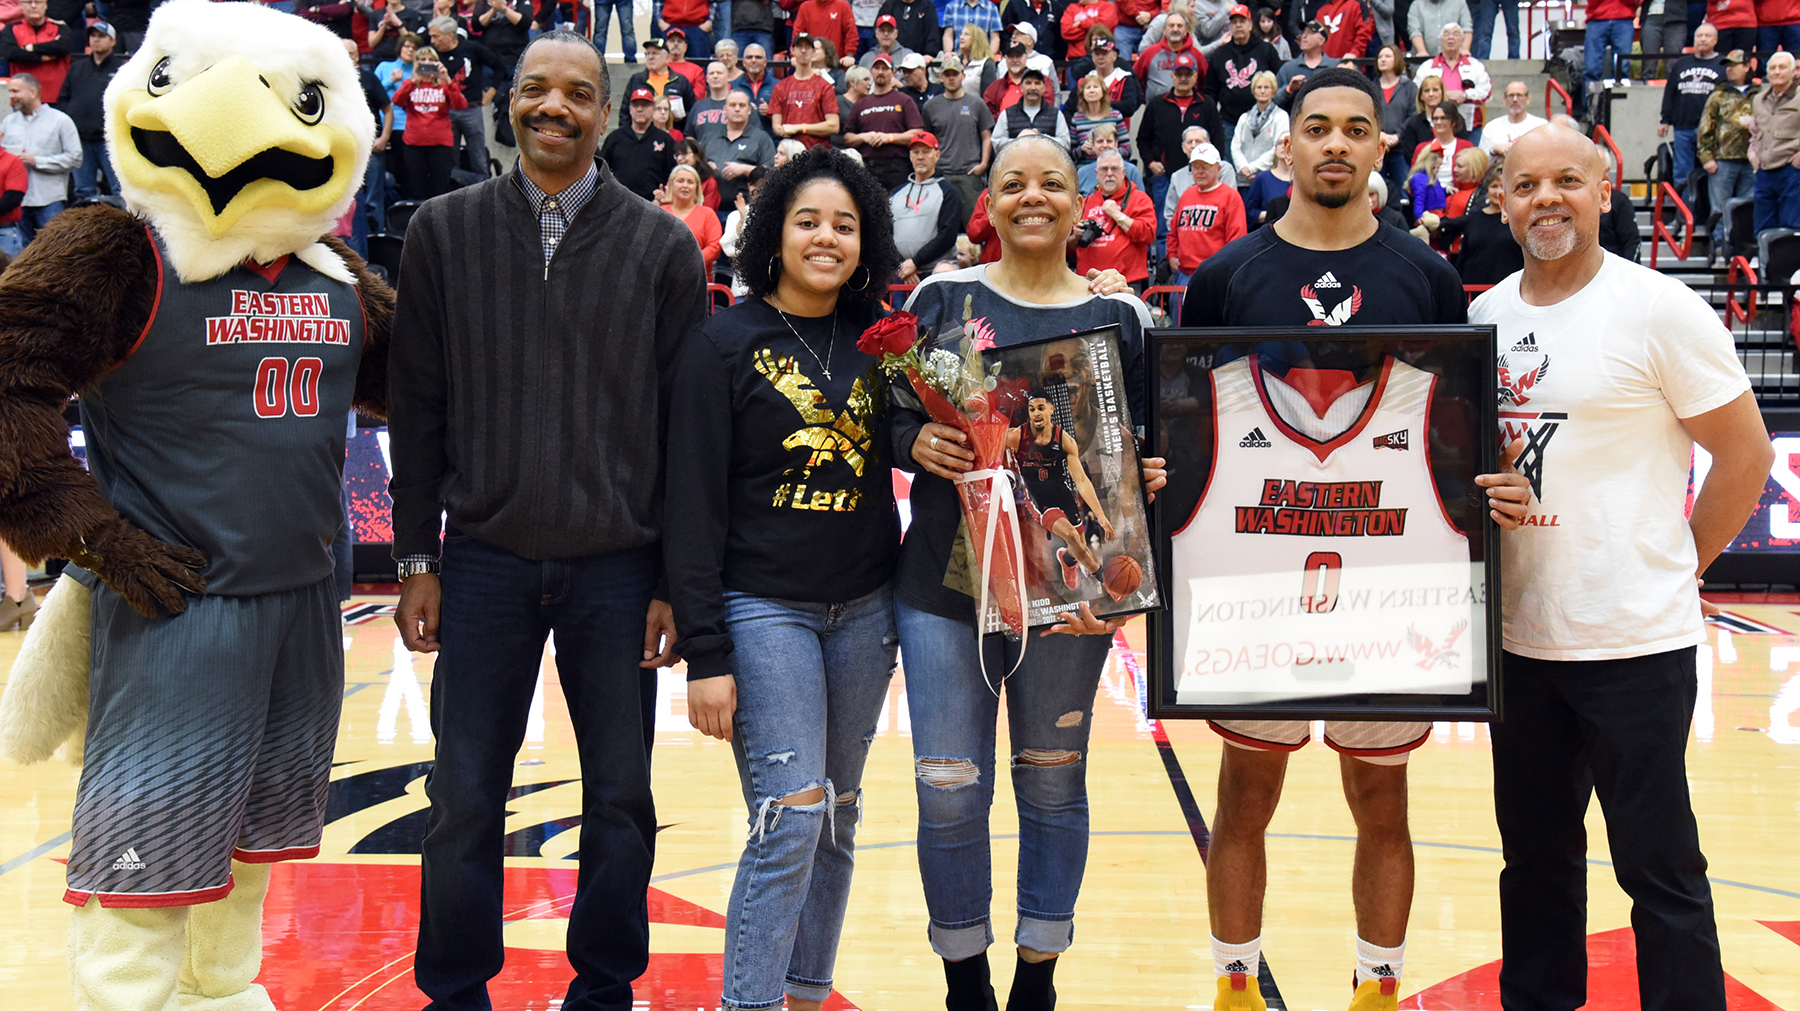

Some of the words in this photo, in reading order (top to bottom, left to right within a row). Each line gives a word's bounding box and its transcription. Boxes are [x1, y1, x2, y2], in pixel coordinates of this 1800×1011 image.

[1178, 208, 1218, 228] EWU
[1314, 281, 1341, 289] adidas
[231, 290, 330, 317] EASTERN
[205, 317, 350, 345] WASHINGTON
[1089, 342, 1100, 380] UNIVERSITY
[1511, 344, 1539, 352] adidas
[253, 357, 323, 418] 00
[1096, 340, 1117, 413] BASKETBALL
[1096, 382, 1108, 424] WASHINGTON
[1103, 425, 1113, 454] EASTERN
[1109, 416, 1124, 453] MEN'S
[1239, 439, 1272, 448] adidas
[1258, 478, 1383, 509] EASTERN
[1235, 506, 1409, 537] WASHINGTON
[1300, 551, 1342, 614] 0
[1031, 598, 1050, 609] KIDD
[1040, 600, 1090, 615] WASHINGTN
[112, 861, 146, 870] adidas
[1225, 964, 1248, 973] adidas
[1371, 966, 1395, 977] adidas
